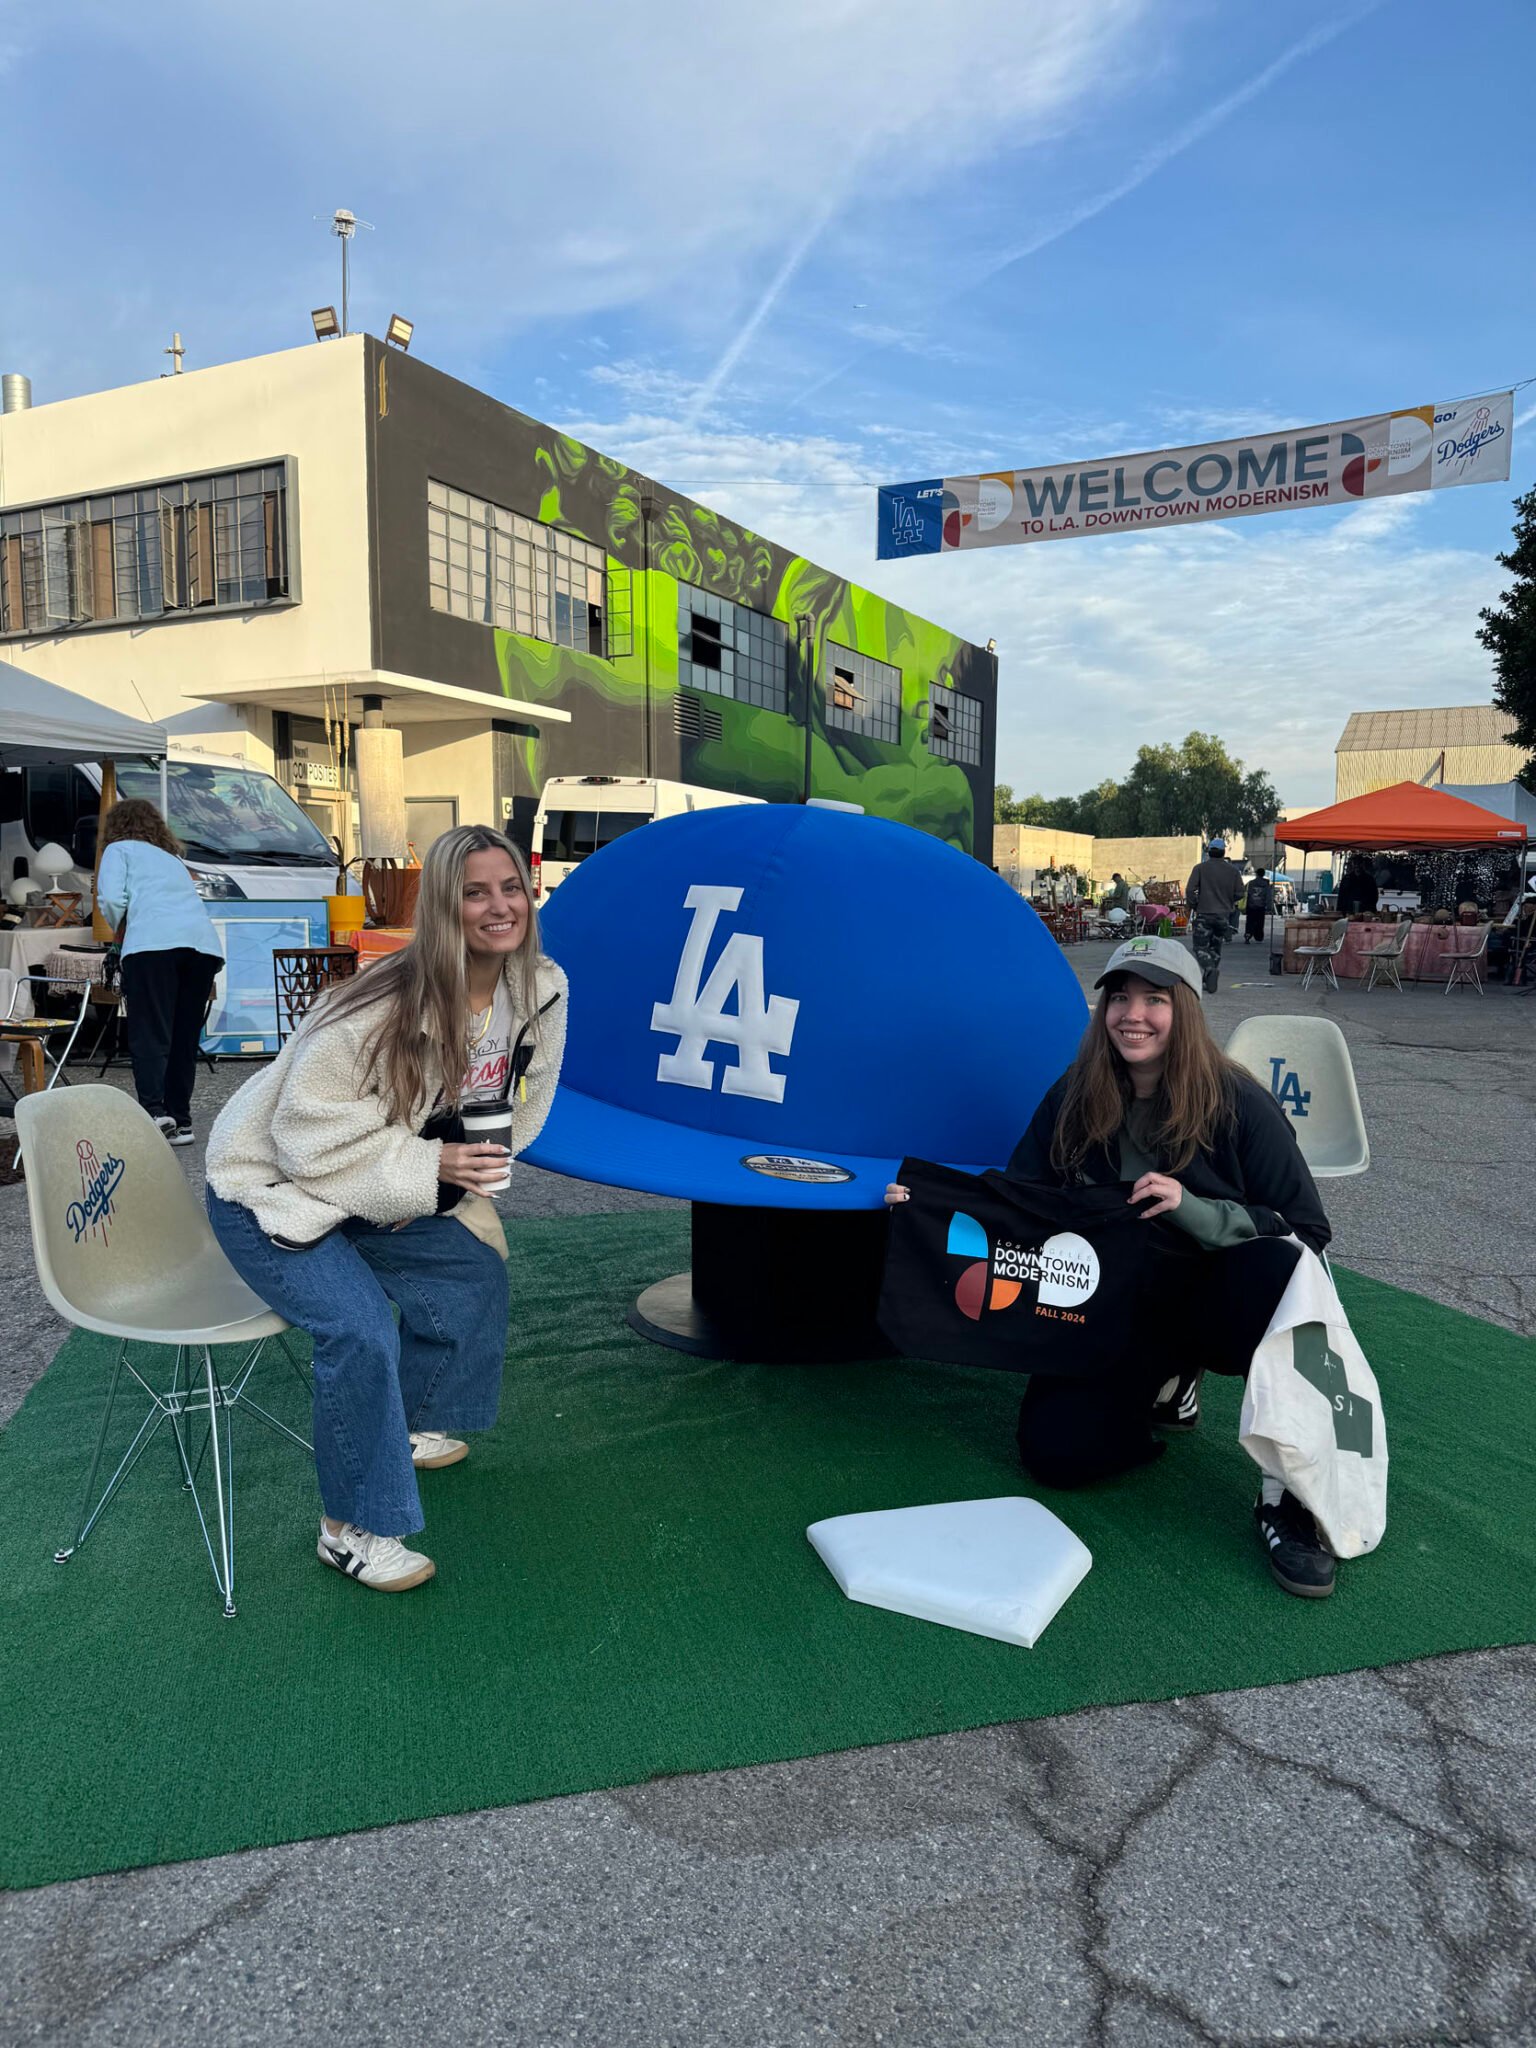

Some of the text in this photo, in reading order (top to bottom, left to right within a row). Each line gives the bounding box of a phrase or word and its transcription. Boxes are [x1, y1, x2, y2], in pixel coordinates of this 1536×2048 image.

[1434, 412, 1457, 424] GO!
[1437, 420, 1505, 464] Dodgers
[917, 488, 944, 499] LET'S
[1022, 435, 1330, 518] WELCOME
[892, 496, 924, 545] LA
[1021, 482, 1330, 535] TO L.A. DOWNTOWN MODERNISM
[293, 761, 337, 783] COMPOSITES
[650, 884, 800, 1103] LA
[1268, 1057, 1311, 1117] LA
[66, 1152, 125, 1243] Dodgers
[995, 1247, 1090, 1276] DOWNTOWN
[997, 1239, 1093, 1262] LOS ANGELES
[993, 1261, 1090, 1290] MODERNISM
[1035, 1306, 1086, 1324] FALL 2024
